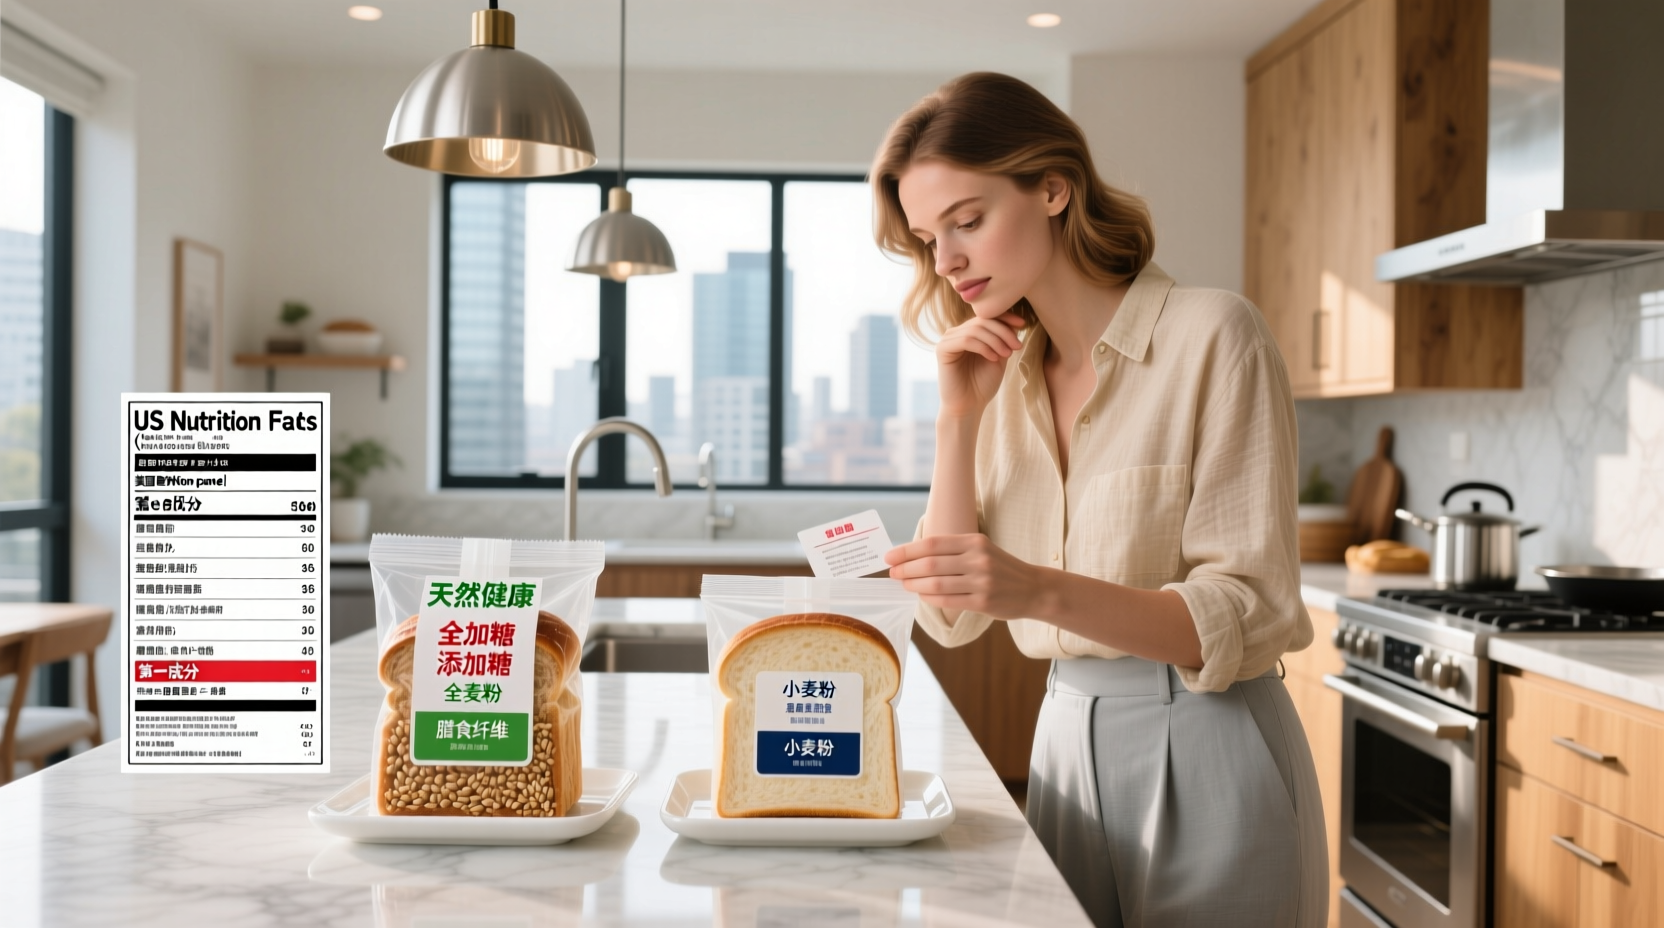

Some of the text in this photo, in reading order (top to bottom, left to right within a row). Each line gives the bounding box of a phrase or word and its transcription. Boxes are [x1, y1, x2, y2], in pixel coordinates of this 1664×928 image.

[427, 581, 536, 608] 天然健康
[437, 620, 516, 647] 全加糖
[436, 650, 513, 676] 添加糖
[444, 682, 502, 703] 全麦粉
[783, 679, 836, 699] 小麦粉
[784, 738, 834, 757] 小麦粉
